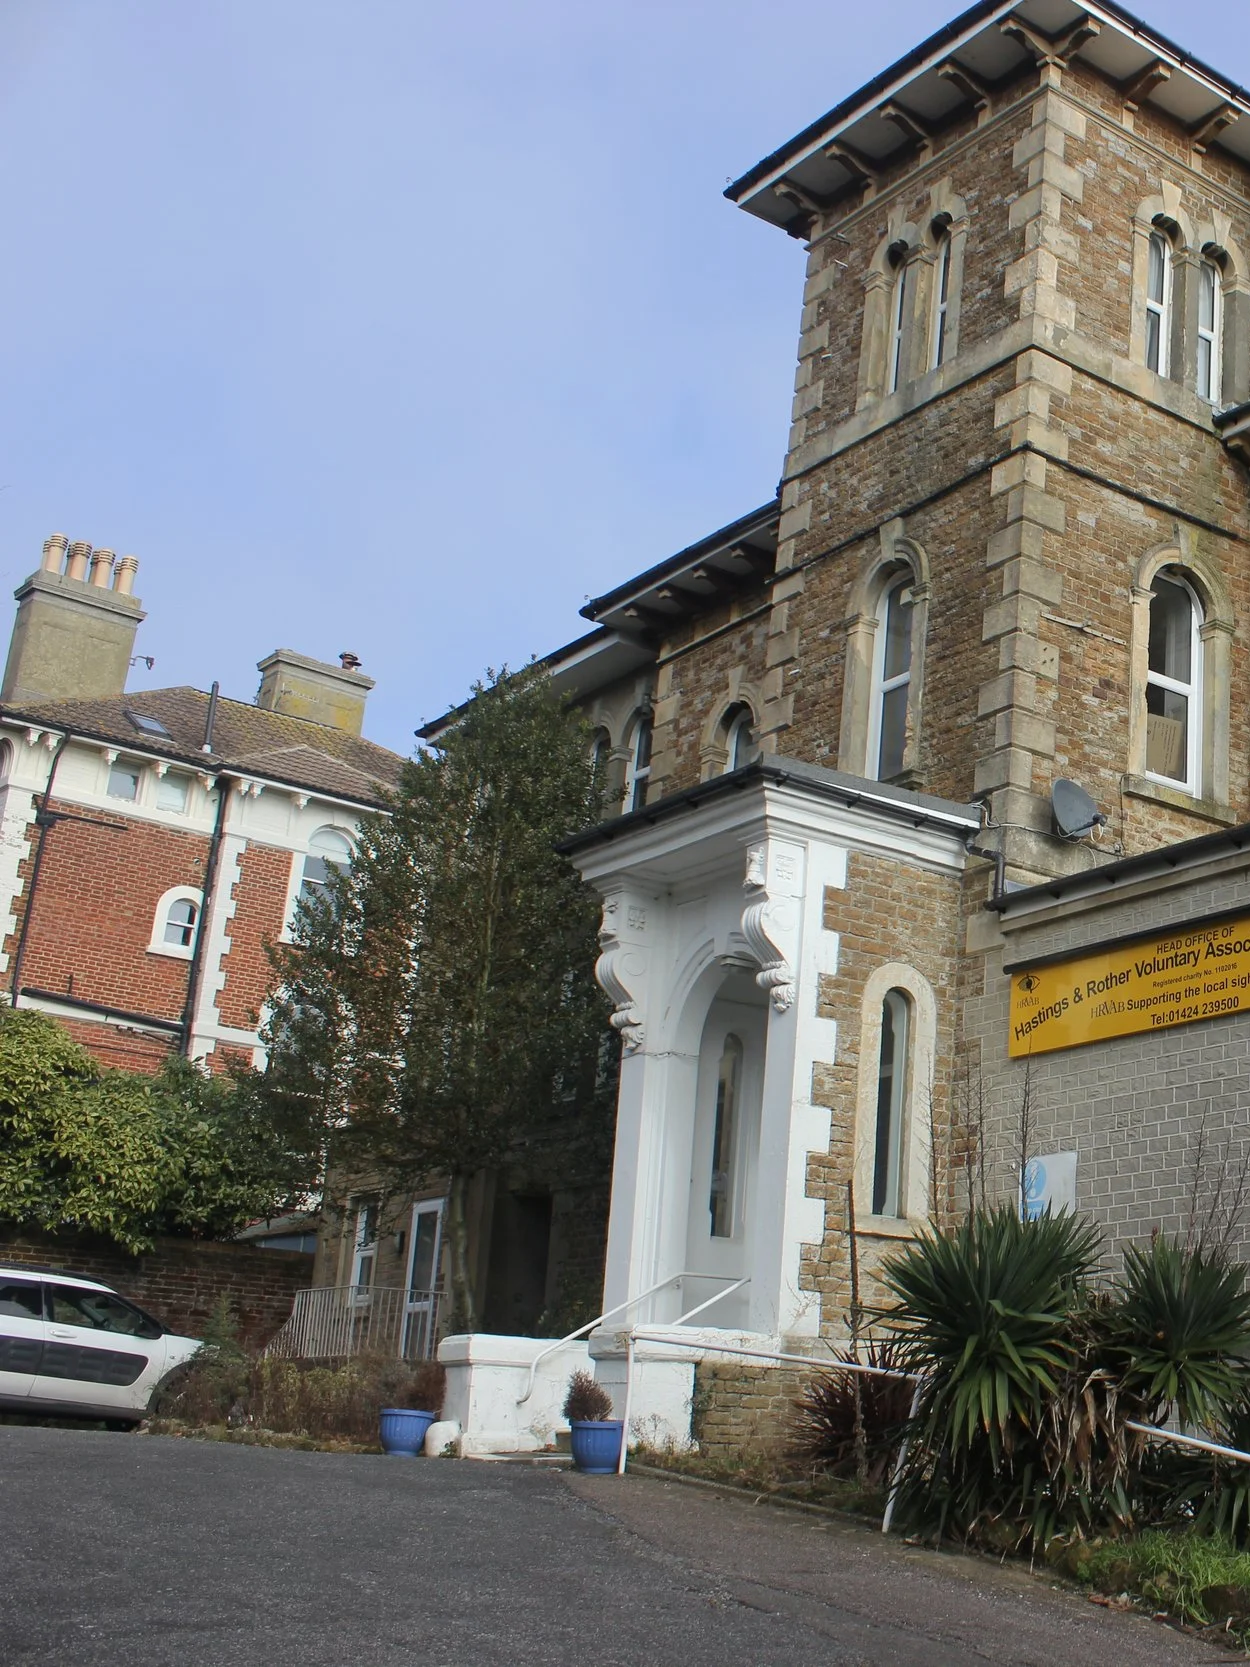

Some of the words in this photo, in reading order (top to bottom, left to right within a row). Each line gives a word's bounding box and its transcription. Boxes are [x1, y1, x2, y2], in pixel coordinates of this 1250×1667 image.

[1156, 940, 1182, 954] HEAD
[1185, 930, 1218, 947] OFFICE
[1221, 926, 1235, 938] OF
[1152, 976, 1182, 988] Registered
[1183, 971, 1202, 981] charity
[1215, 962, 1237, 974] 1102016
[1014, 997, 1069, 1041] Hastings
[1073, 987, 1083, 1003] &
[1086, 969, 1131, 998] Rother
[1135, 949, 1200, 978] Voluntary
[1127, 991, 1181, 1011] Supporting
[1184, 986, 1200, 999] the
[1203, 978, 1228, 994] local
[1151, 1004, 1199, 1025] Tel:01424
[1202, 996, 1239, 1015] 239500
